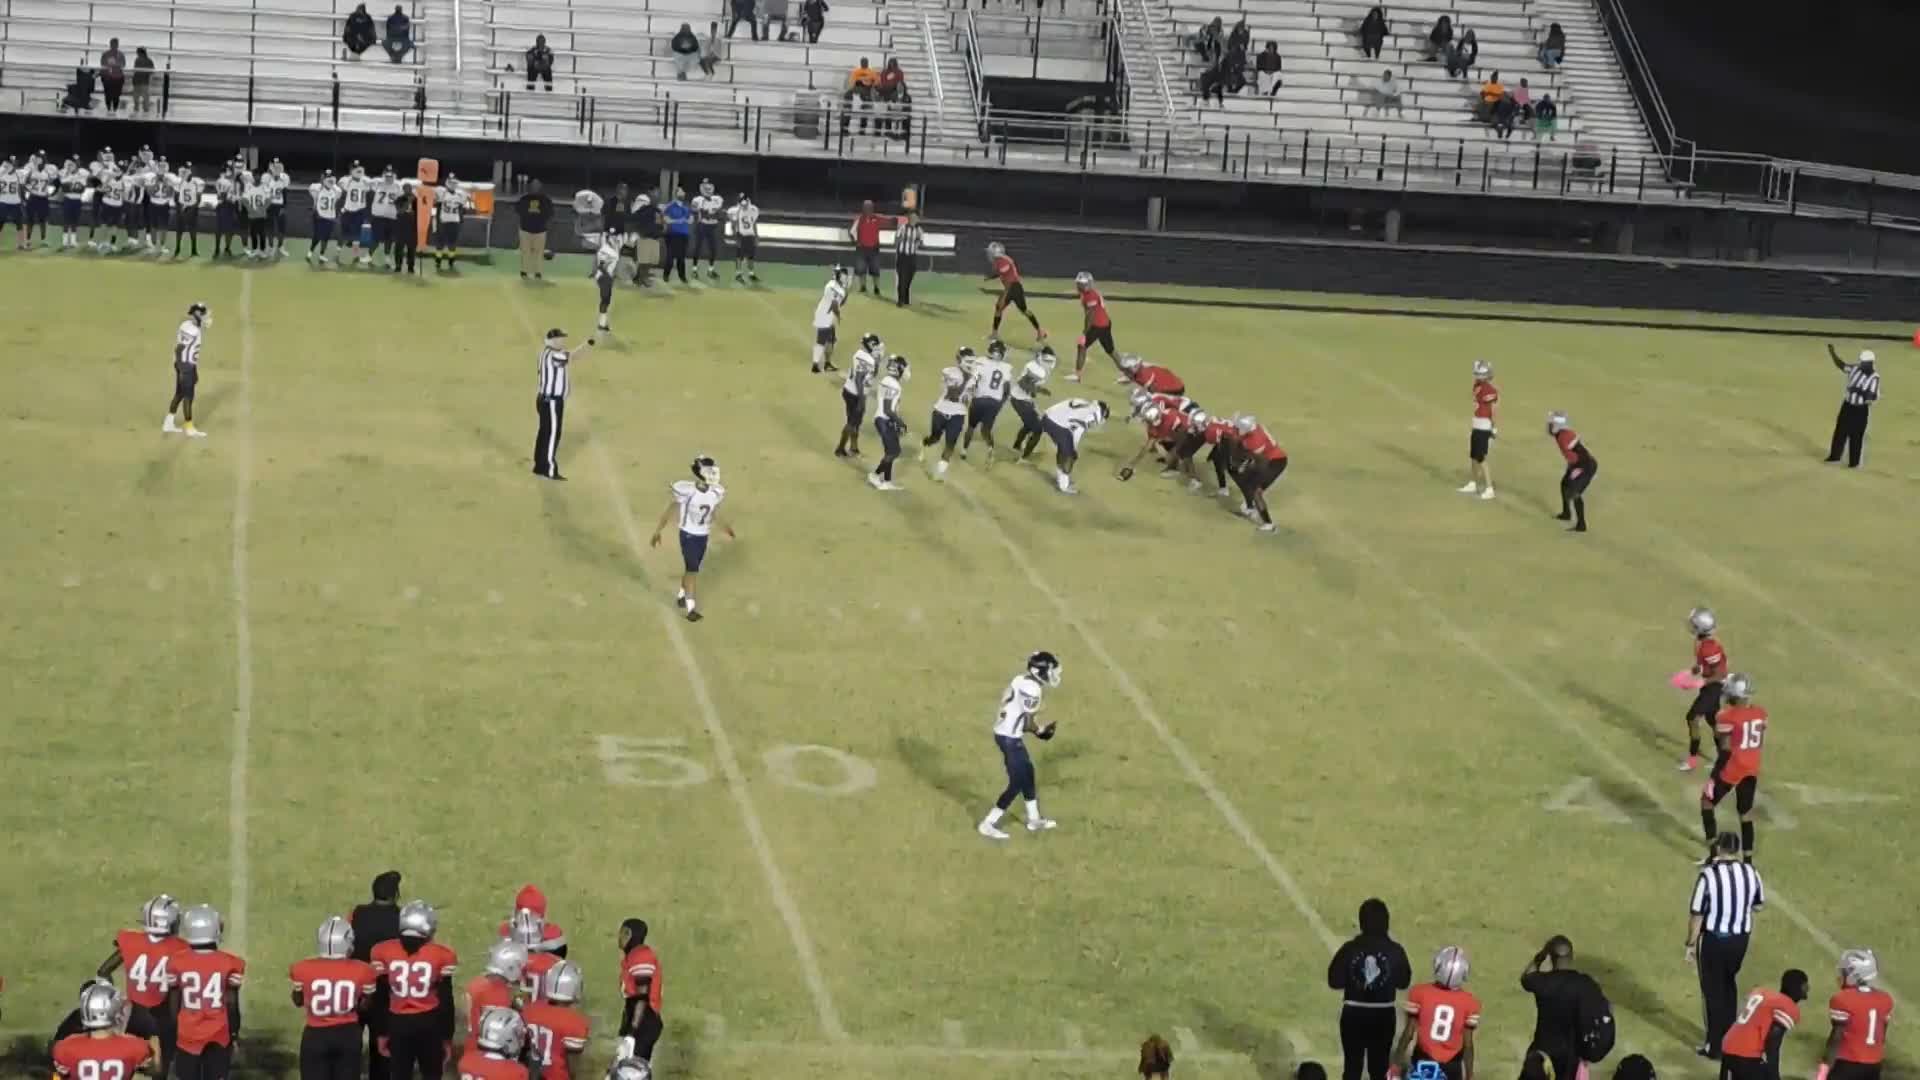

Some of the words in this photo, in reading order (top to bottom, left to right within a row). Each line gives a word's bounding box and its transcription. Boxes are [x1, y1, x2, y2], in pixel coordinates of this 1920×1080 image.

[319, 197, 336, 212] 31
[989, 368, 1003, 390] 8
[1739, 718, 1765, 750] 15
[129, 953, 170, 993] 44
[181, 970, 224, 1011] 24
[387, 959, 433, 999] 33
[310, 978, 356, 1017] 20
[1429, 1004, 1455, 1043] 8
[1866, 1008, 1877, 1045] 1
